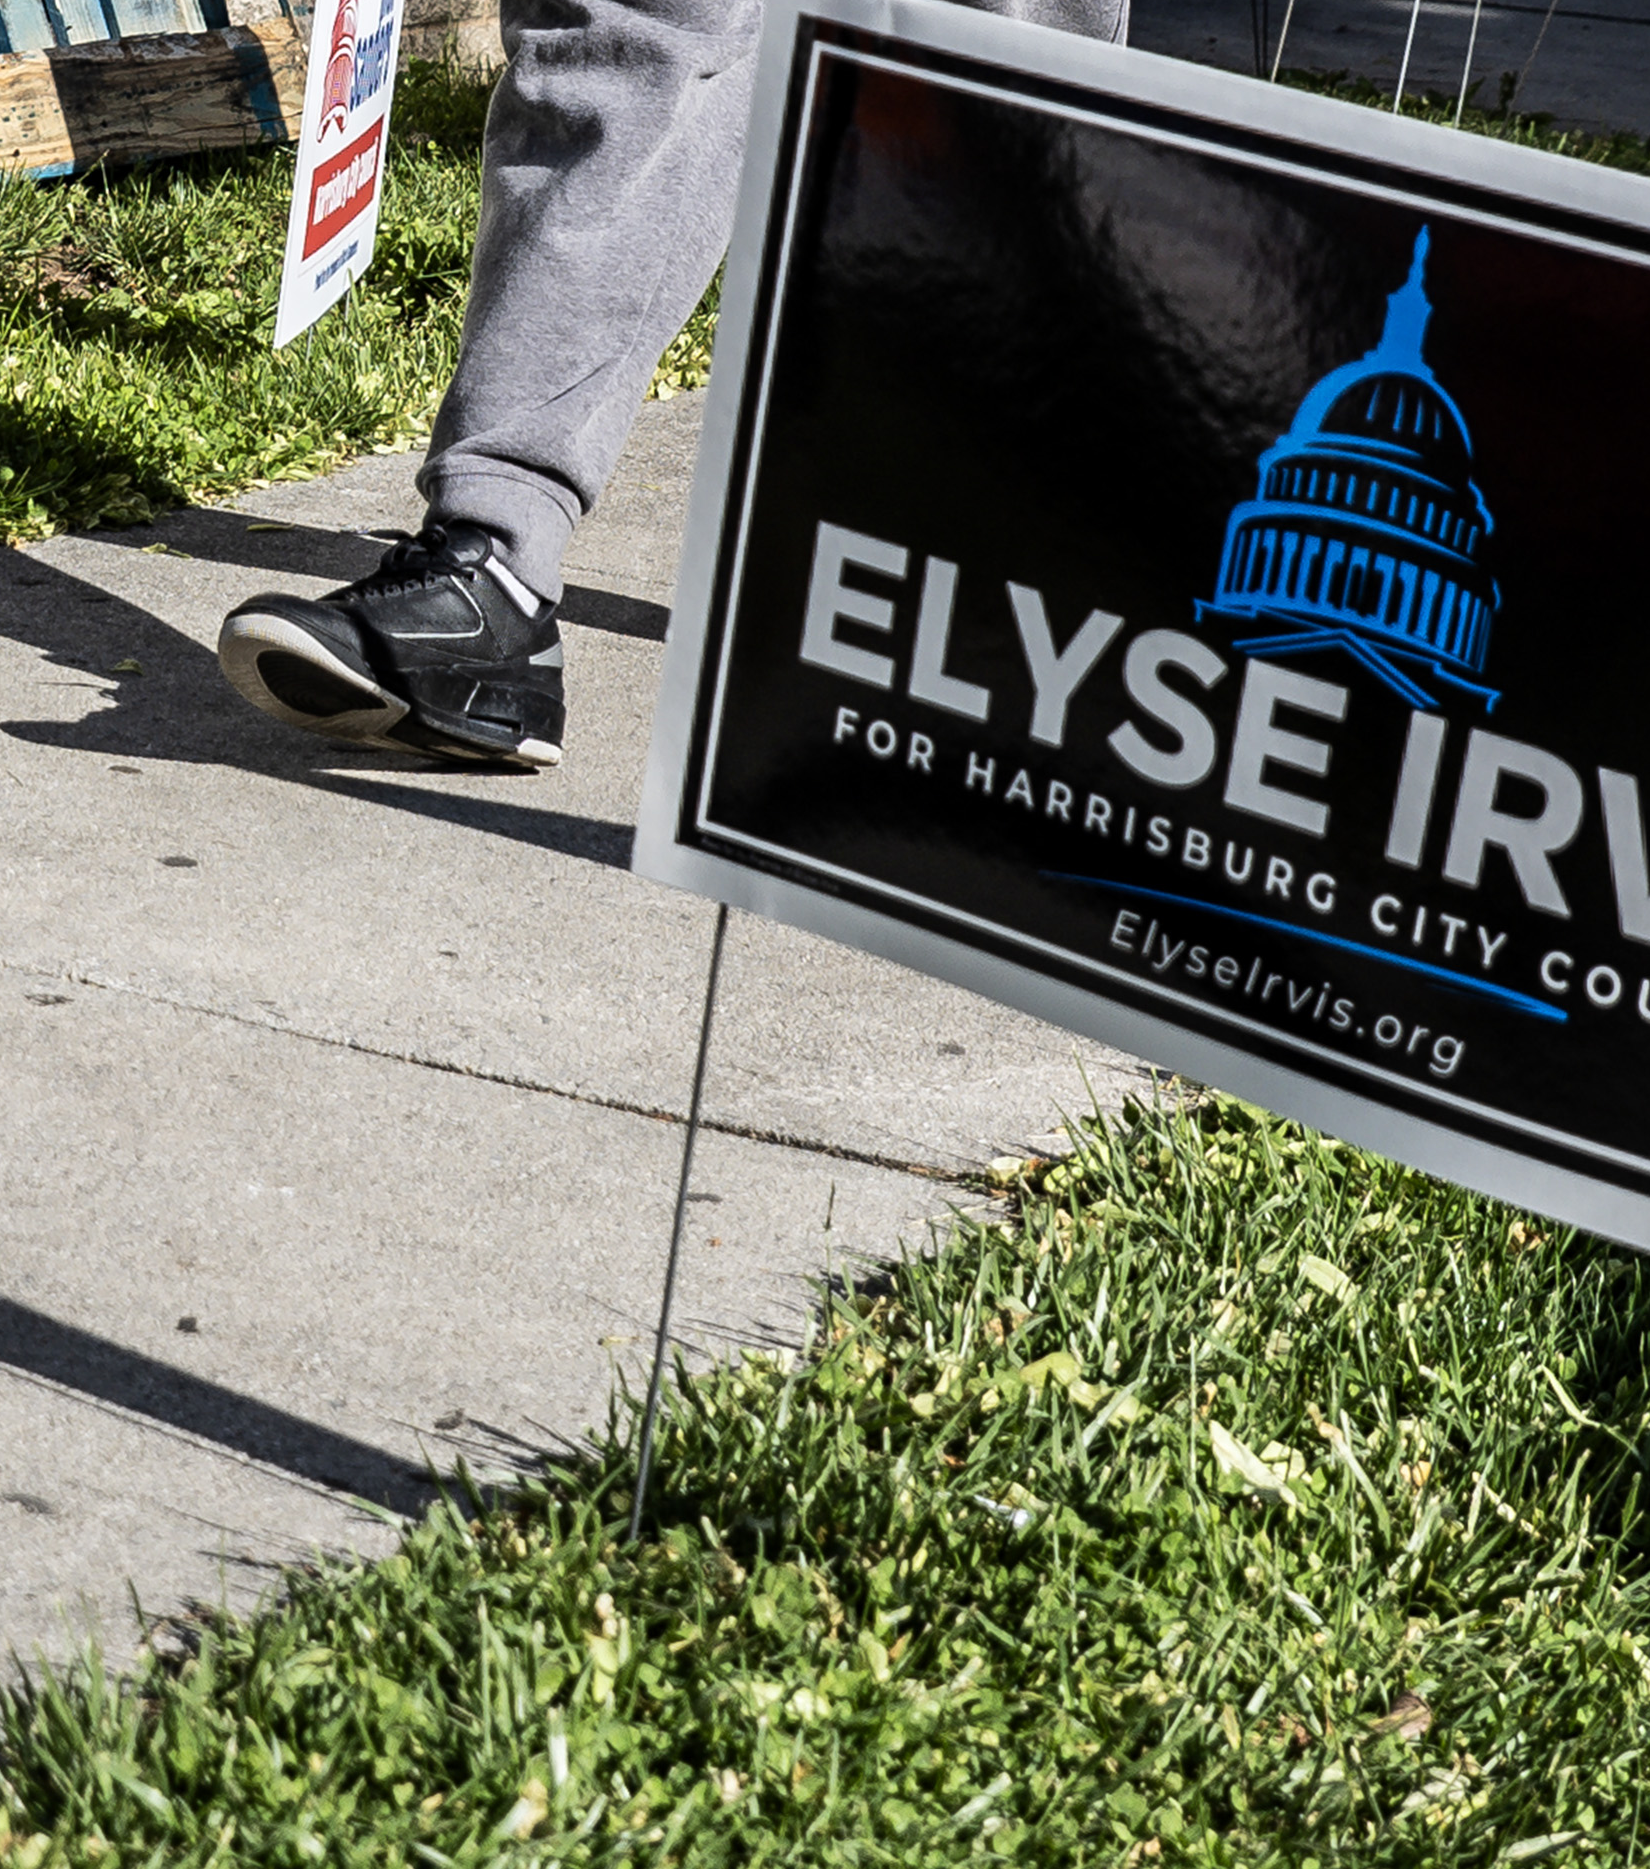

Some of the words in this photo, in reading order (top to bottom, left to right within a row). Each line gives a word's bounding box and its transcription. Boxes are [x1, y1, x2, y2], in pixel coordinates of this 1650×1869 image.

[799, 519, 1350, 838] ELYSE
[833, 706, 936, 774] FOR
[965, 752, 1338, 914] HARRISBURG
[1370, 893, 1507, 969] CITY
[1108, 908, 1466, 1076] ElyseIrvis.org
